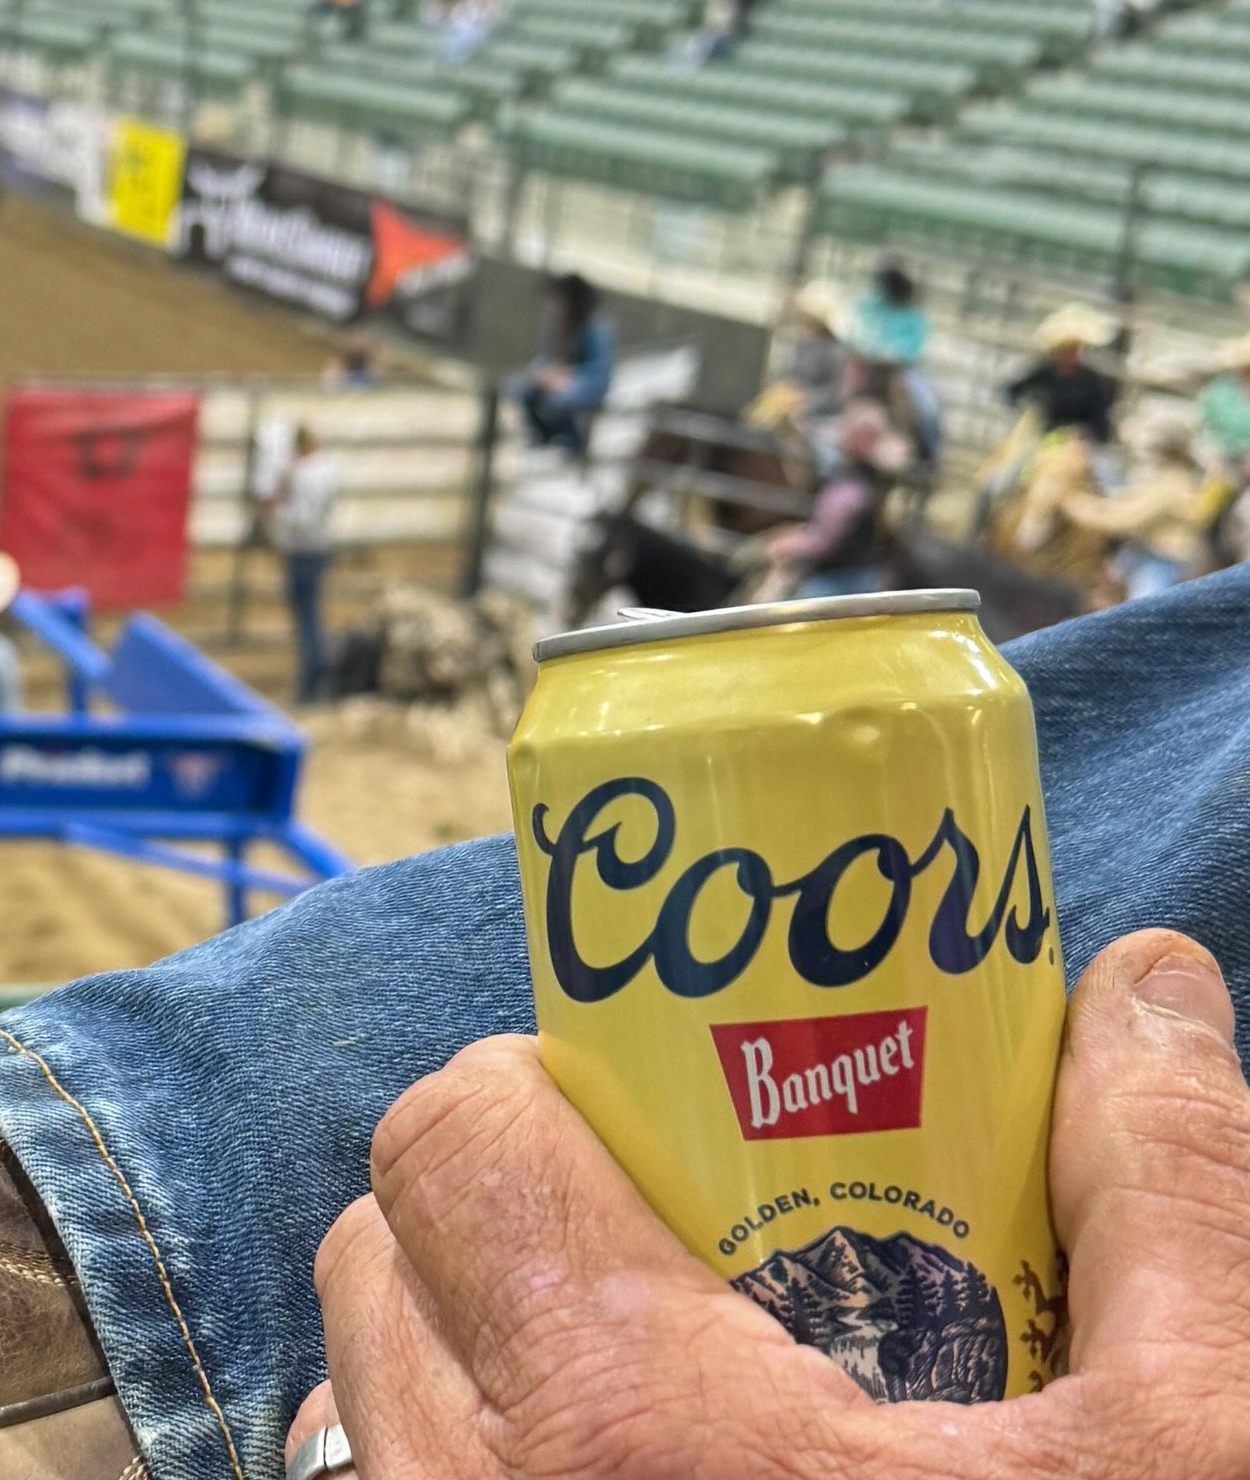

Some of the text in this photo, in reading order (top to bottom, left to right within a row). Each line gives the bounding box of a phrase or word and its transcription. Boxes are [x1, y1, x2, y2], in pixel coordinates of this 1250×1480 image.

[532, 776, 1050, 1003] Coors
[740, 1020, 915, 1129] Banquet
[718, 1181, 970, 1256] GOLDEN, COLORADO
